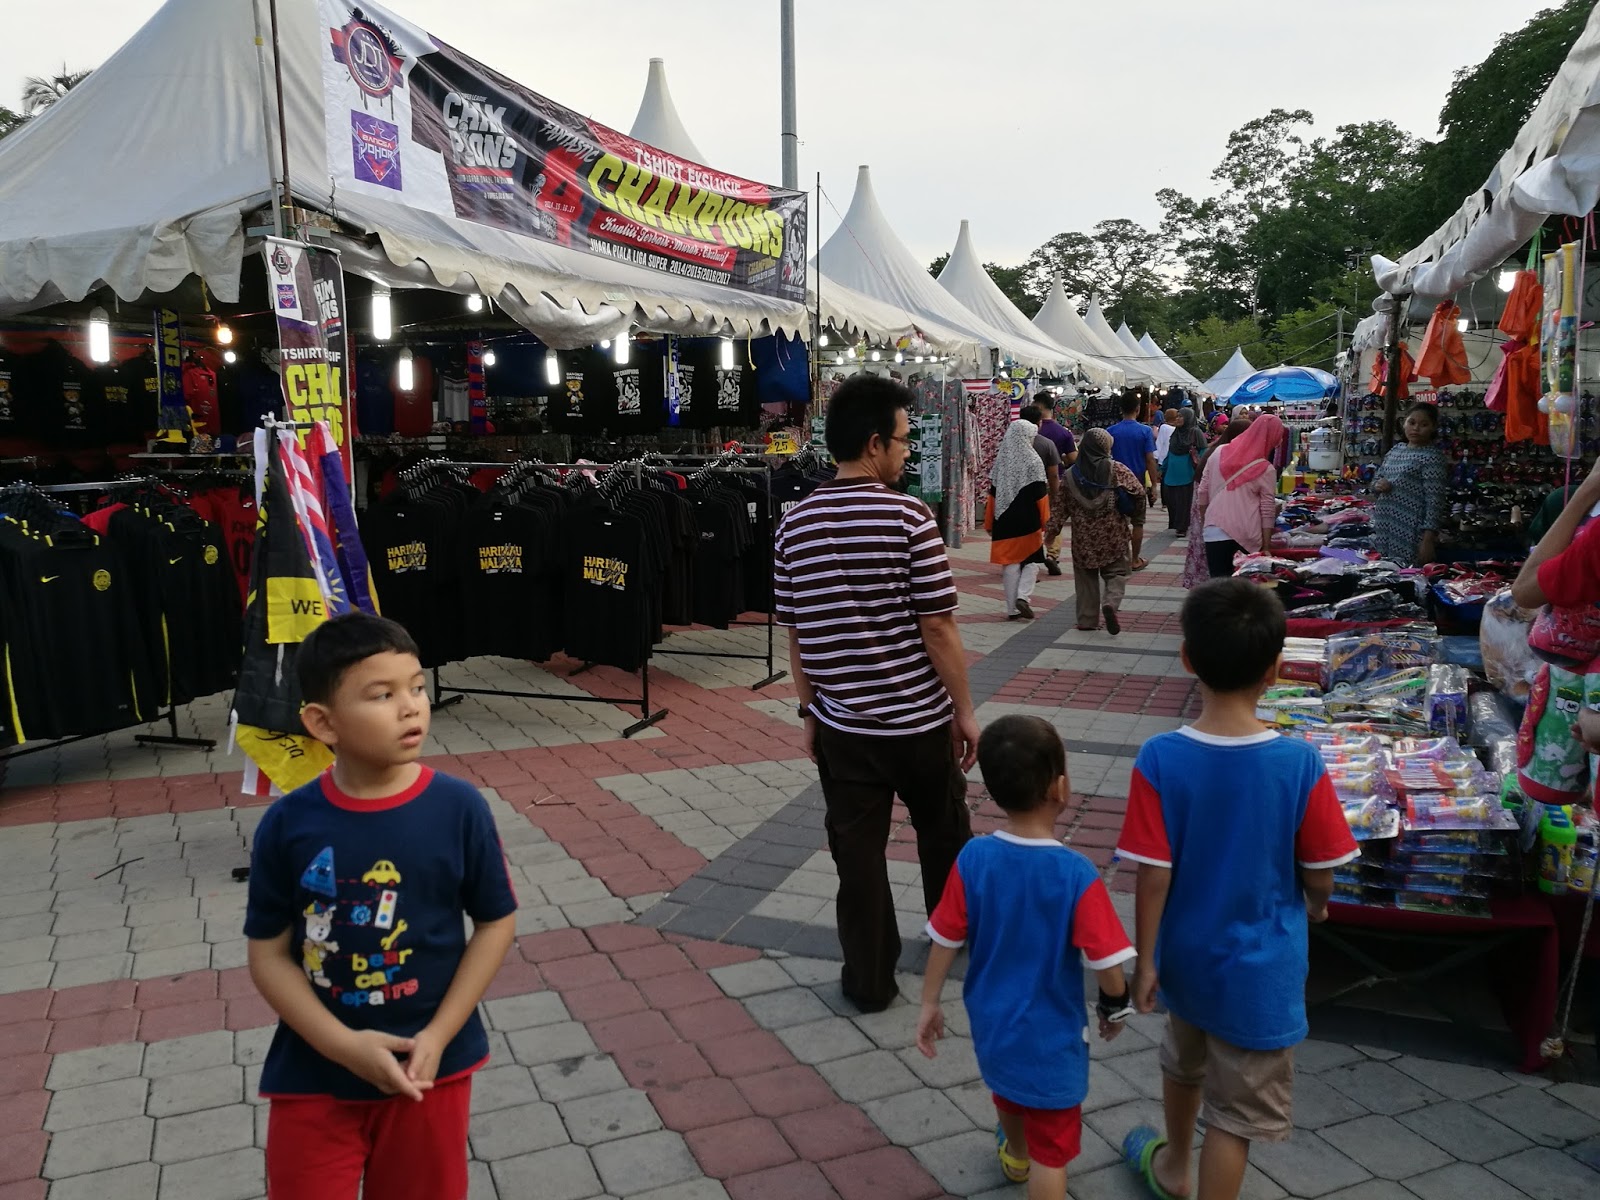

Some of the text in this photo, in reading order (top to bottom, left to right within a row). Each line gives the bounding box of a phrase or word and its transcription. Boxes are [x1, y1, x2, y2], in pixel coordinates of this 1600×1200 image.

[539, 119, 599, 163] FANTASTIC
[634, 147, 684, 182] TSHIRT
[588, 153, 784, 259] CHAMPIONS
[590, 238, 612, 257] JUARA
[612, 244, 632, 262] PIALA
[632, 250, 647, 266] LIGA
[648, 253, 668, 271] SUPER
[281, 348, 322, 361] TSHIRT
[1415, 392, 1437, 403] RM10
[774, 441, 788, 452] 25
[290, 599, 323, 616] WE
[351, 948, 413, 972] bear
[354, 965, 401, 989] car
[331, 978, 419, 1008] repairs
